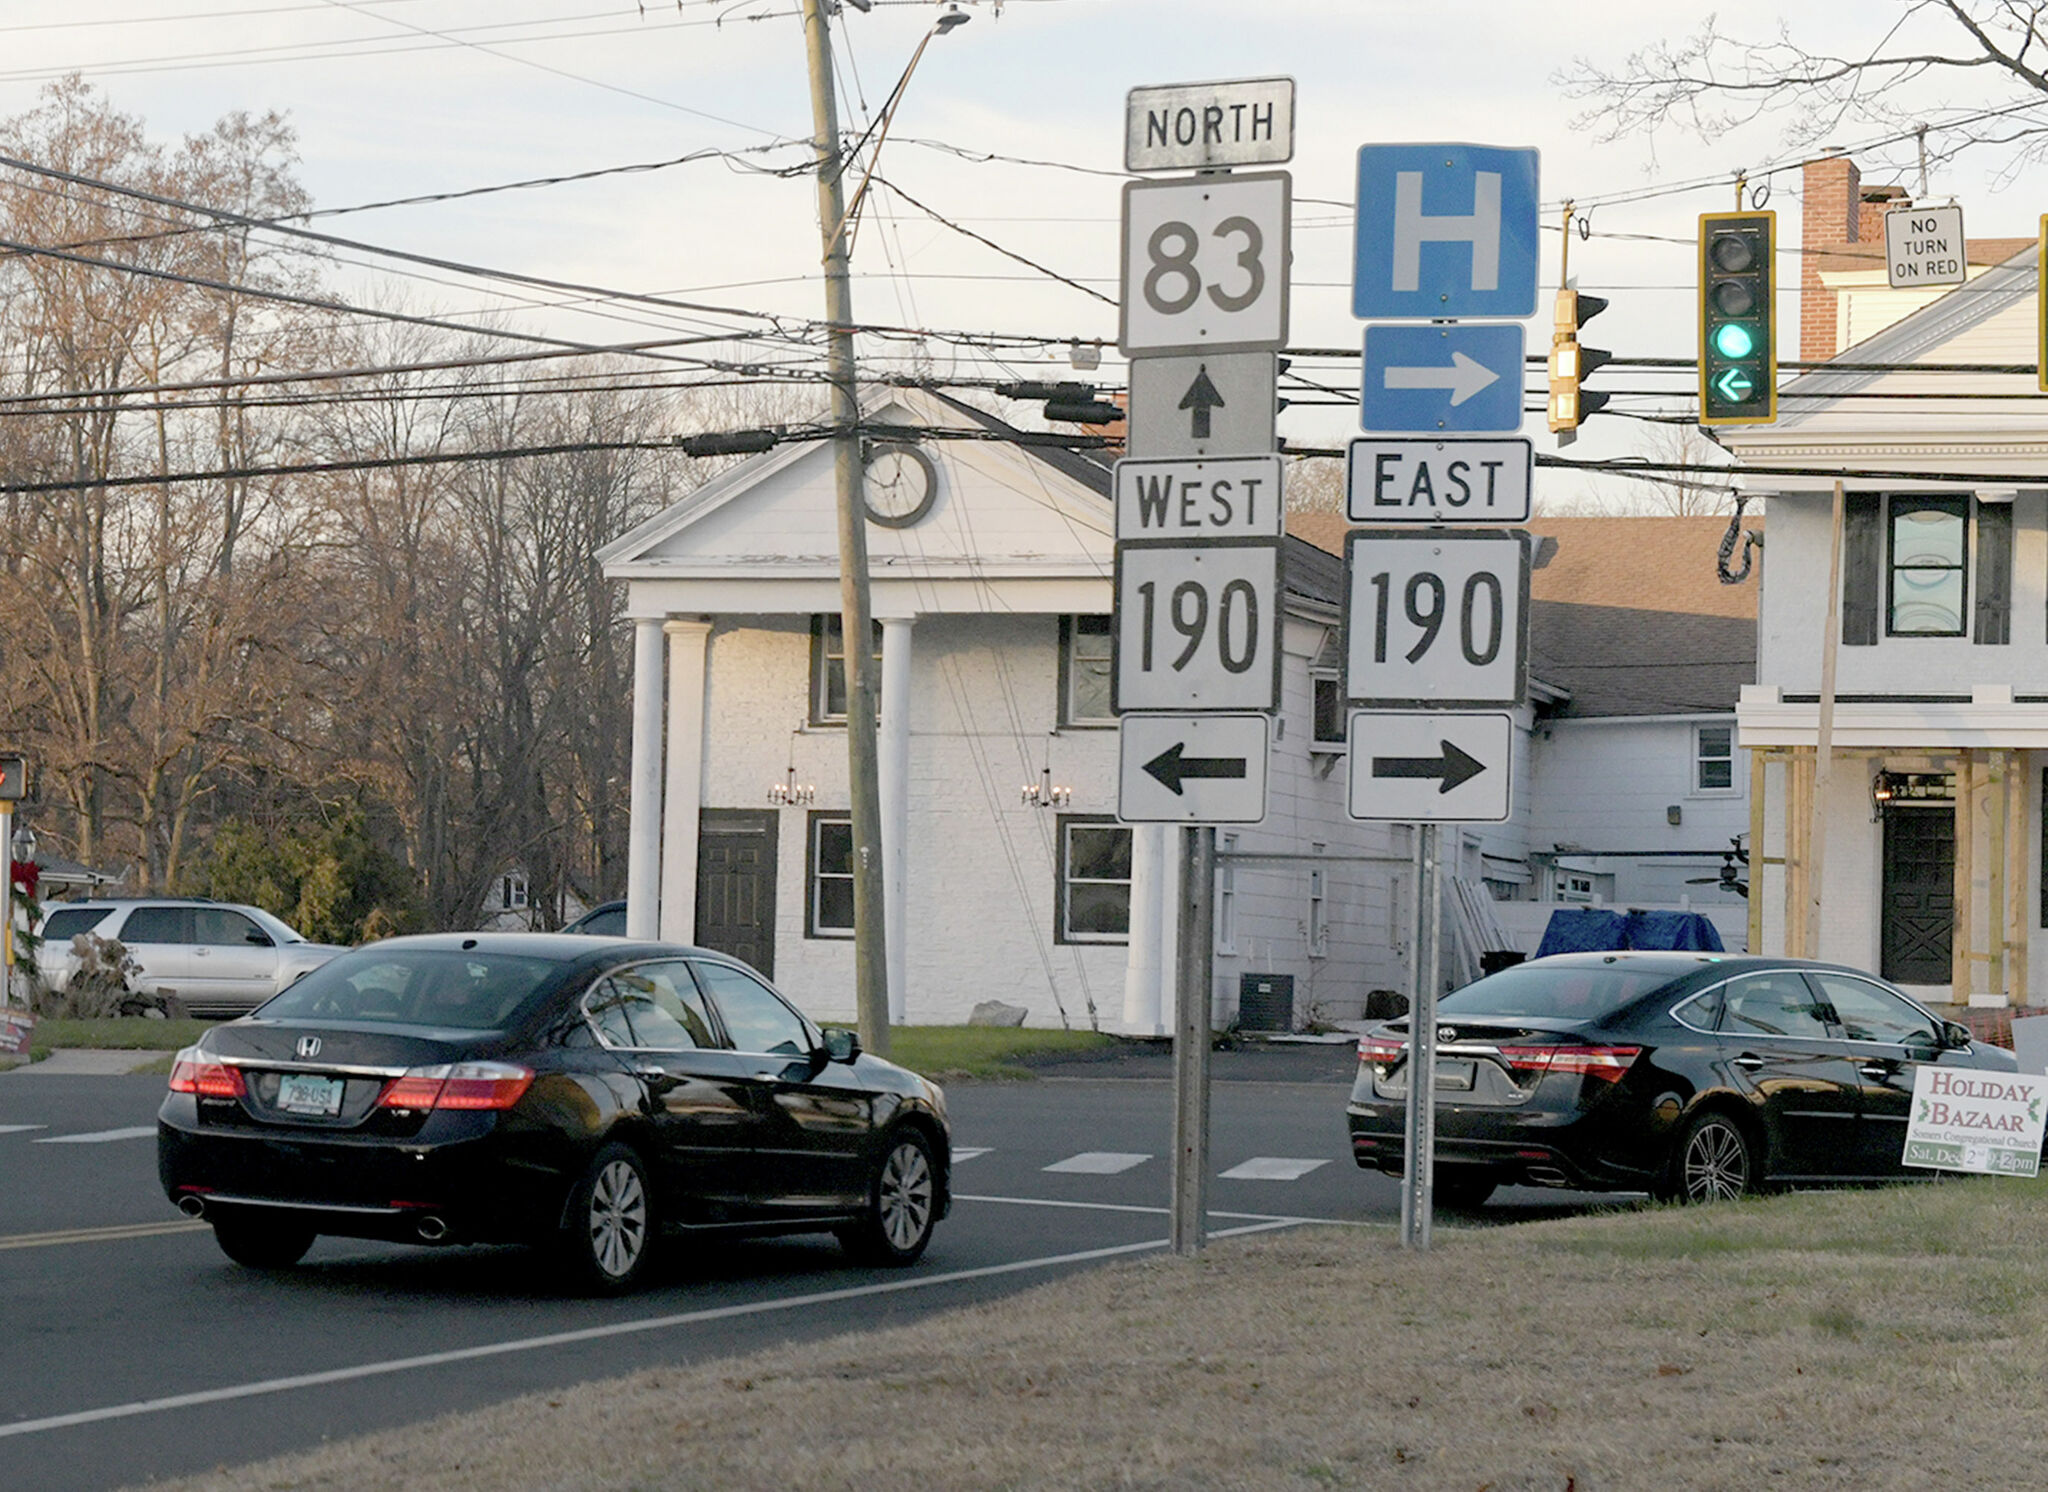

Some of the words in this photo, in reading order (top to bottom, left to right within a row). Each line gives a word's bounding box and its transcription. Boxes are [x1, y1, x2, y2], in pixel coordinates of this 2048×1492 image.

[1147, 102, 1273, 148] NORTH
[1392, 170, 1502, 291] H
[1904, 239, 1947, 255] TURN
[1911, 218, 1937, 234] NO
[1143, 215, 1265, 315] 83
[1896, 263, 1918, 278] ON
[1926, 259, 1958, 275] RED
[1136, 475, 1263, 528] WEST
[1374, 453, 1504, 507] EAST
[1138, 578, 1259, 674] 190
[1370, 571, 1503, 667] 190
[1929, 1071, 2034, 1103] HOLIDAY
[1929, 1102, 2025, 1133] BAZAAR
[2007, 1136, 2039, 1150] Church
